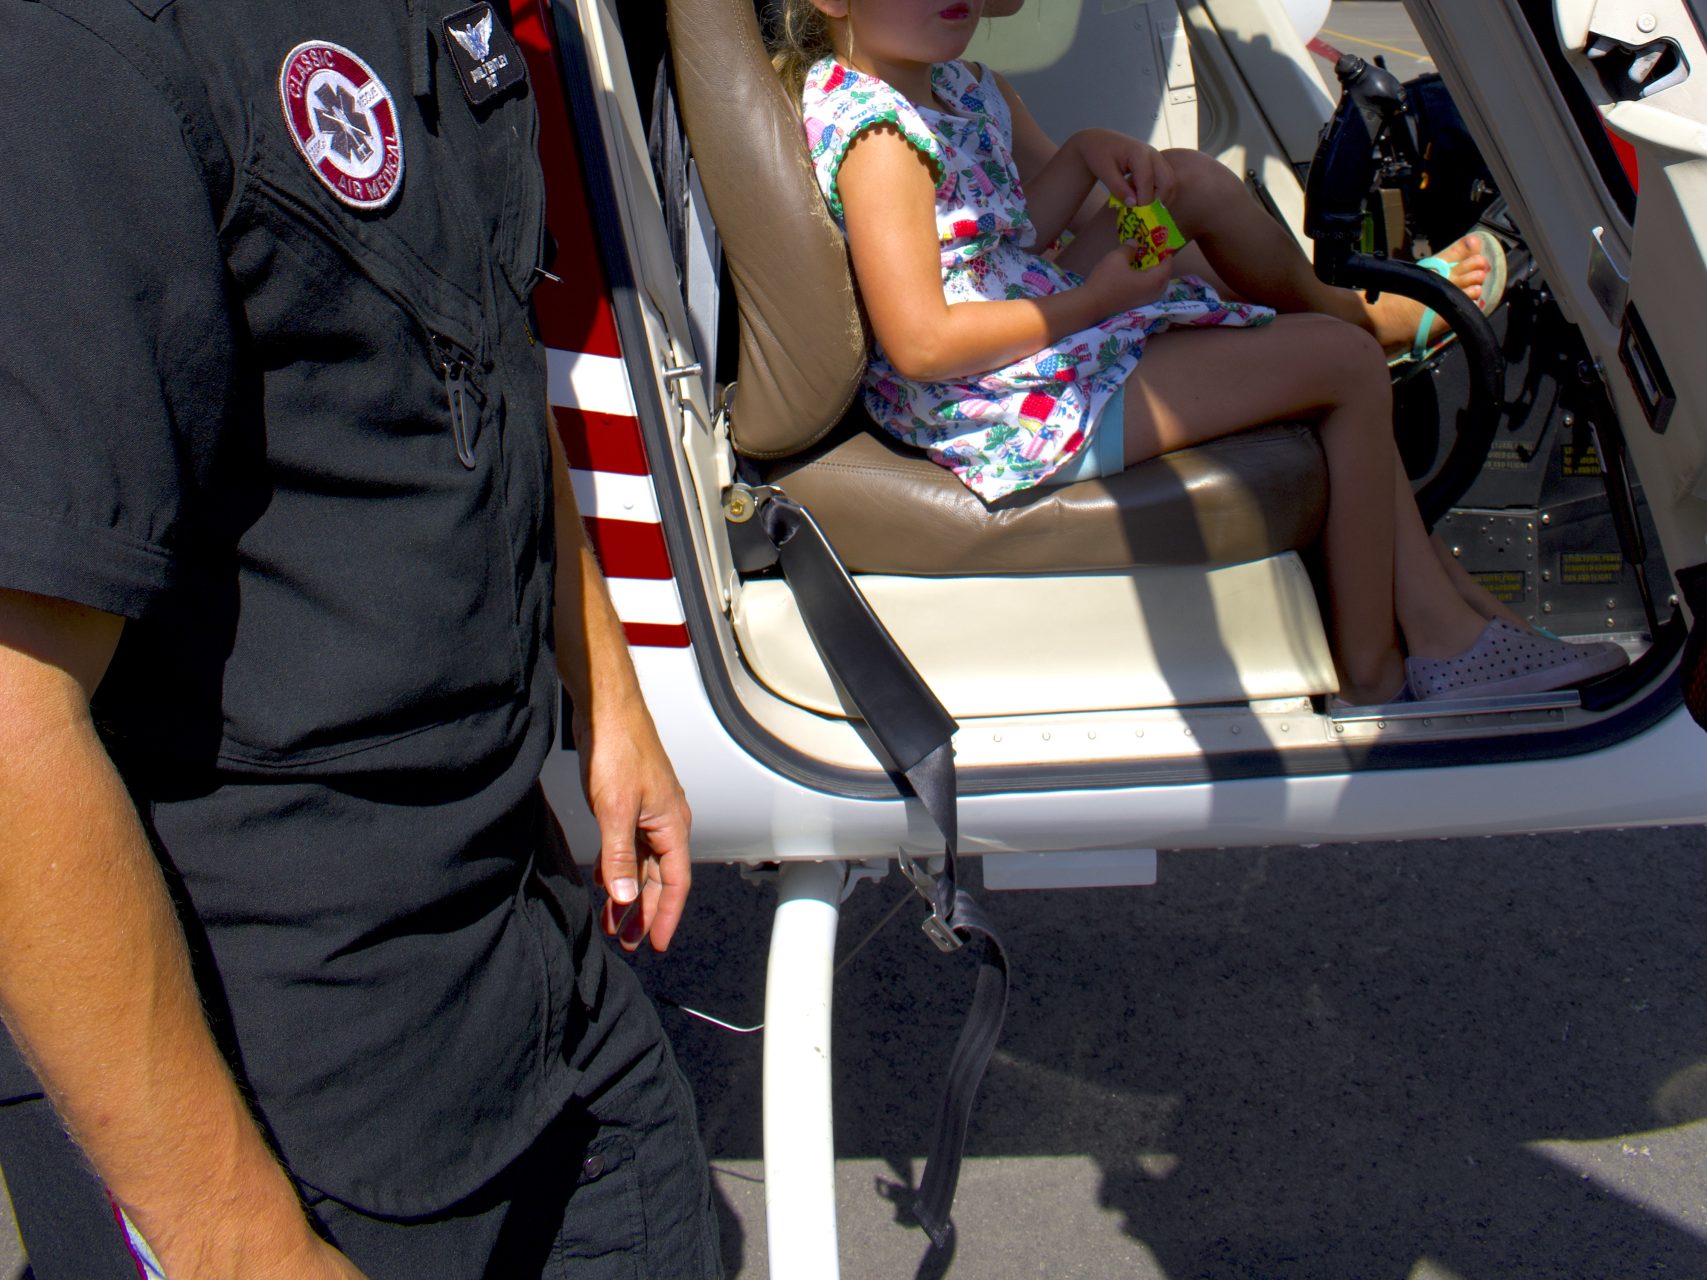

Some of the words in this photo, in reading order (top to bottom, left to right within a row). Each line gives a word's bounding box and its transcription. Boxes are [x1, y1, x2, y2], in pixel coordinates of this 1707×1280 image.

[288, 49, 336, 98] CLASSIC
[338, 175, 364, 200] AIR
[365, 136, 400, 200] MEDICAL
